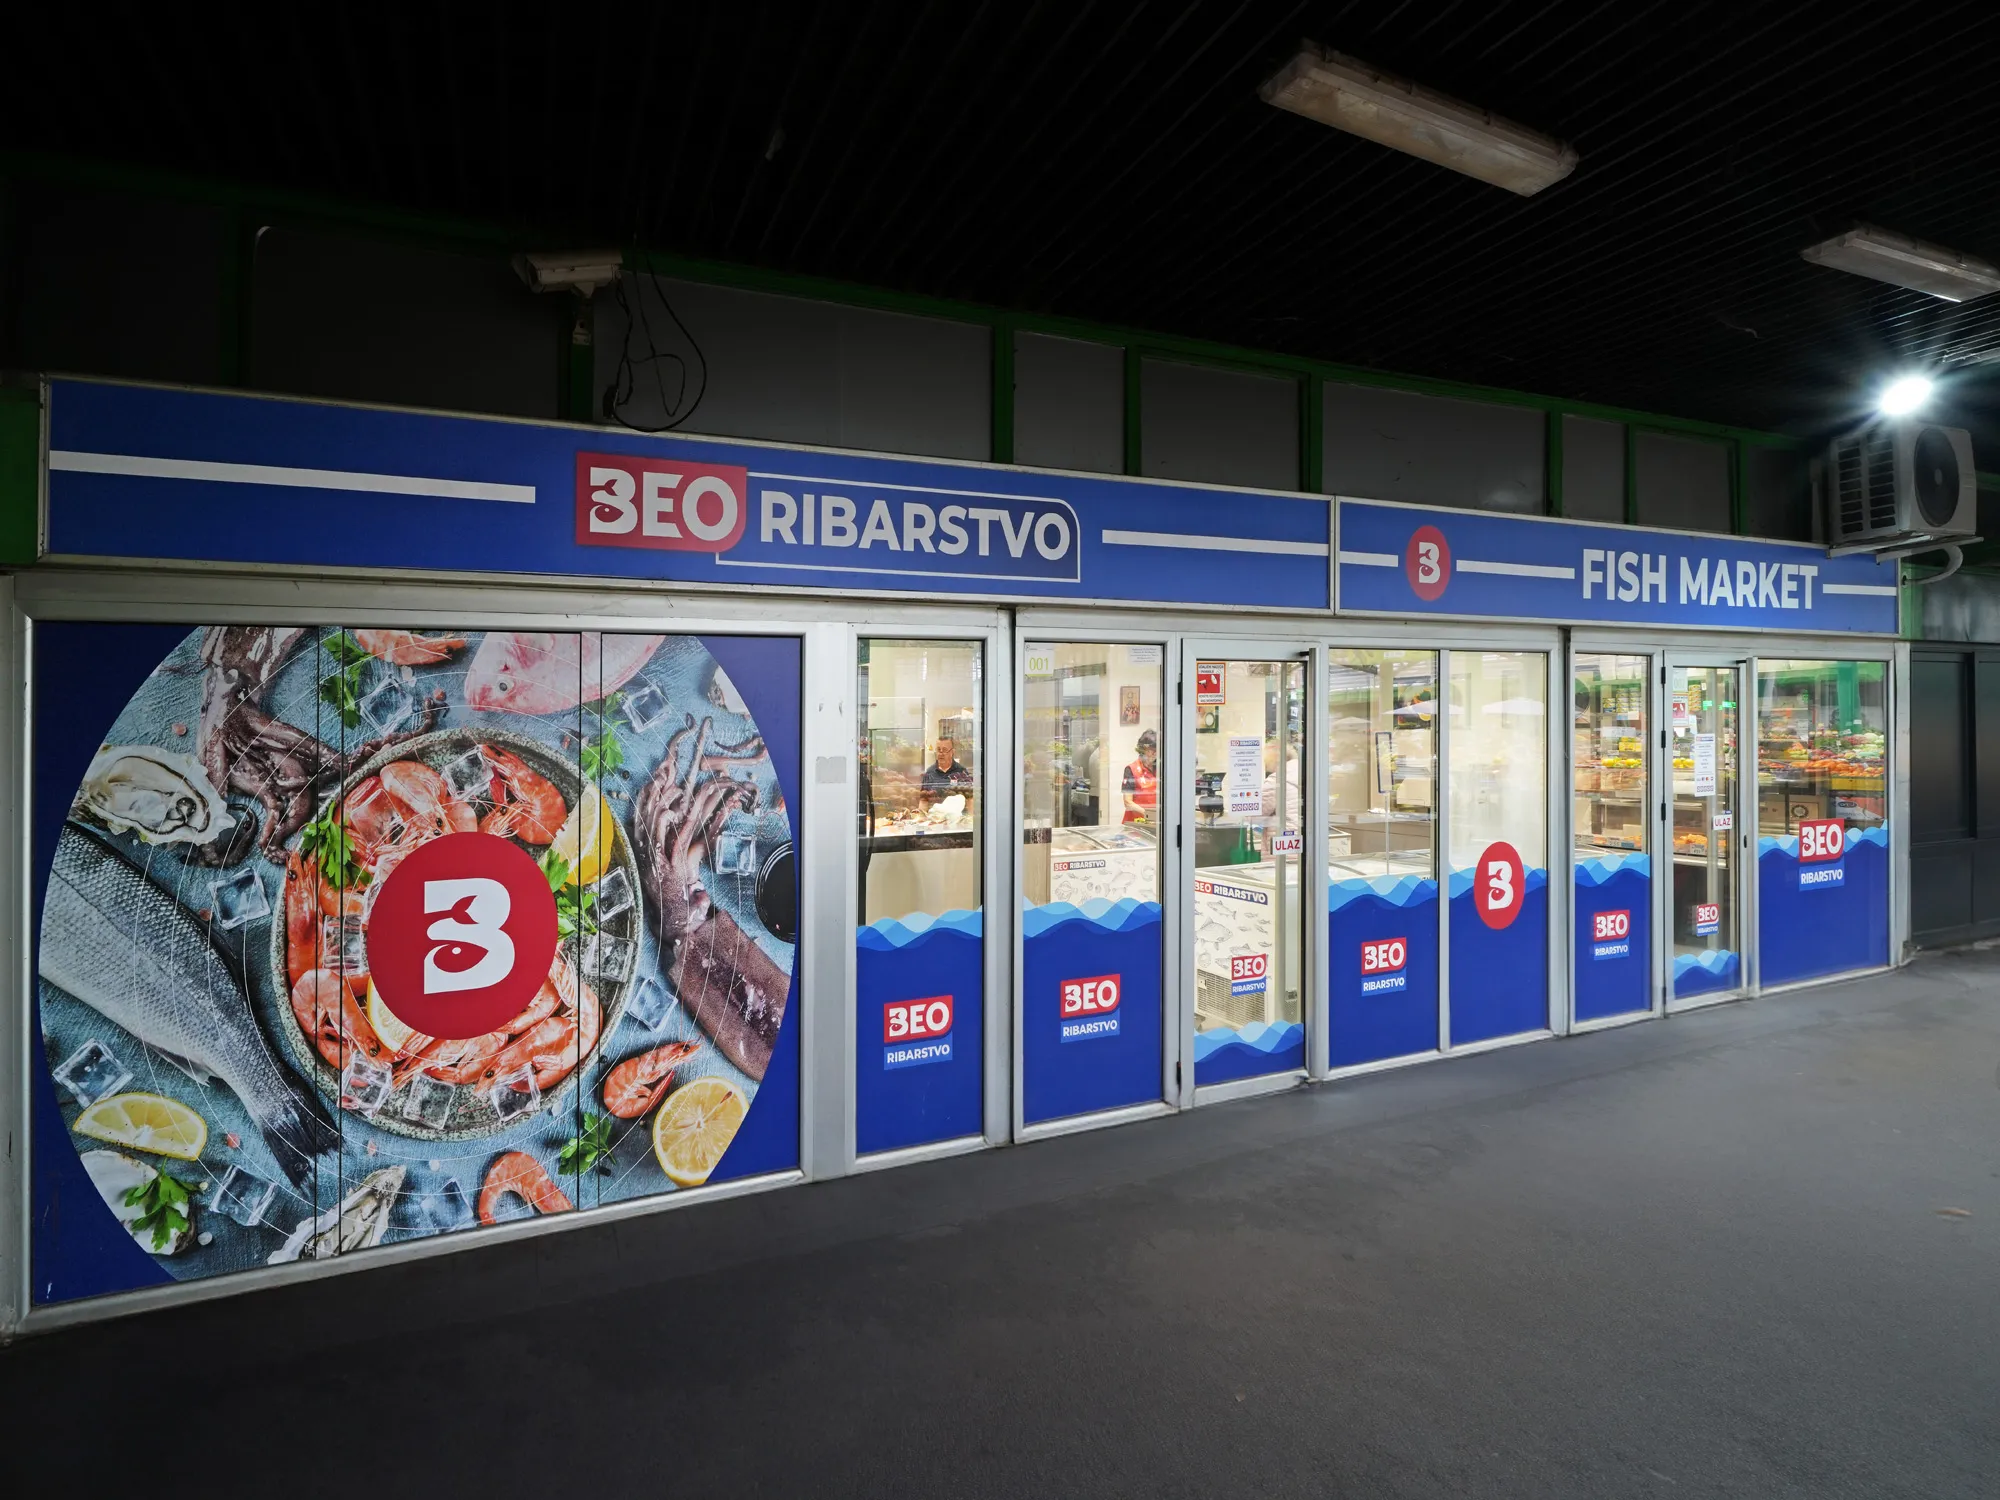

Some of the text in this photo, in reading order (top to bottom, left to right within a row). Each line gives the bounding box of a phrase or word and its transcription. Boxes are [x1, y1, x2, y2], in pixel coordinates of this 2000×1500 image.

[589, 466, 1071, 560] BEO RIBARSTVO
[1583, 548, 1818, 610] FISH MARKET
[1029, 657, 1049, 671] 001
[1715, 817, 1731, 827] ULAZ
[1275, 839, 1300, 851] ULAZ
[1802, 823, 1843, 857] BEO
[1800, 868, 1843, 885] RIBARSTVO
[1213, 885, 1266, 903] RIBARSTVO
[1698, 905, 1718, 922] BEO
[1594, 913, 1629, 939] BEO
[1364, 942, 1405, 971] BEO
[1594, 944, 1629, 957] RIBARSTVO
[1233, 957, 1265, 978] BEO
[1232, 982, 1266, 993] RIBARSTVO
[1363, 975, 1405, 992] RIBARSTVO
[1063, 979, 1117, 1013] BEO
[889, 1001, 950, 1037] BEO
[1063, 1018, 1118, 1037] RIBARSTVO
[887, 1043, 950, 1063] RIBARSTVO
